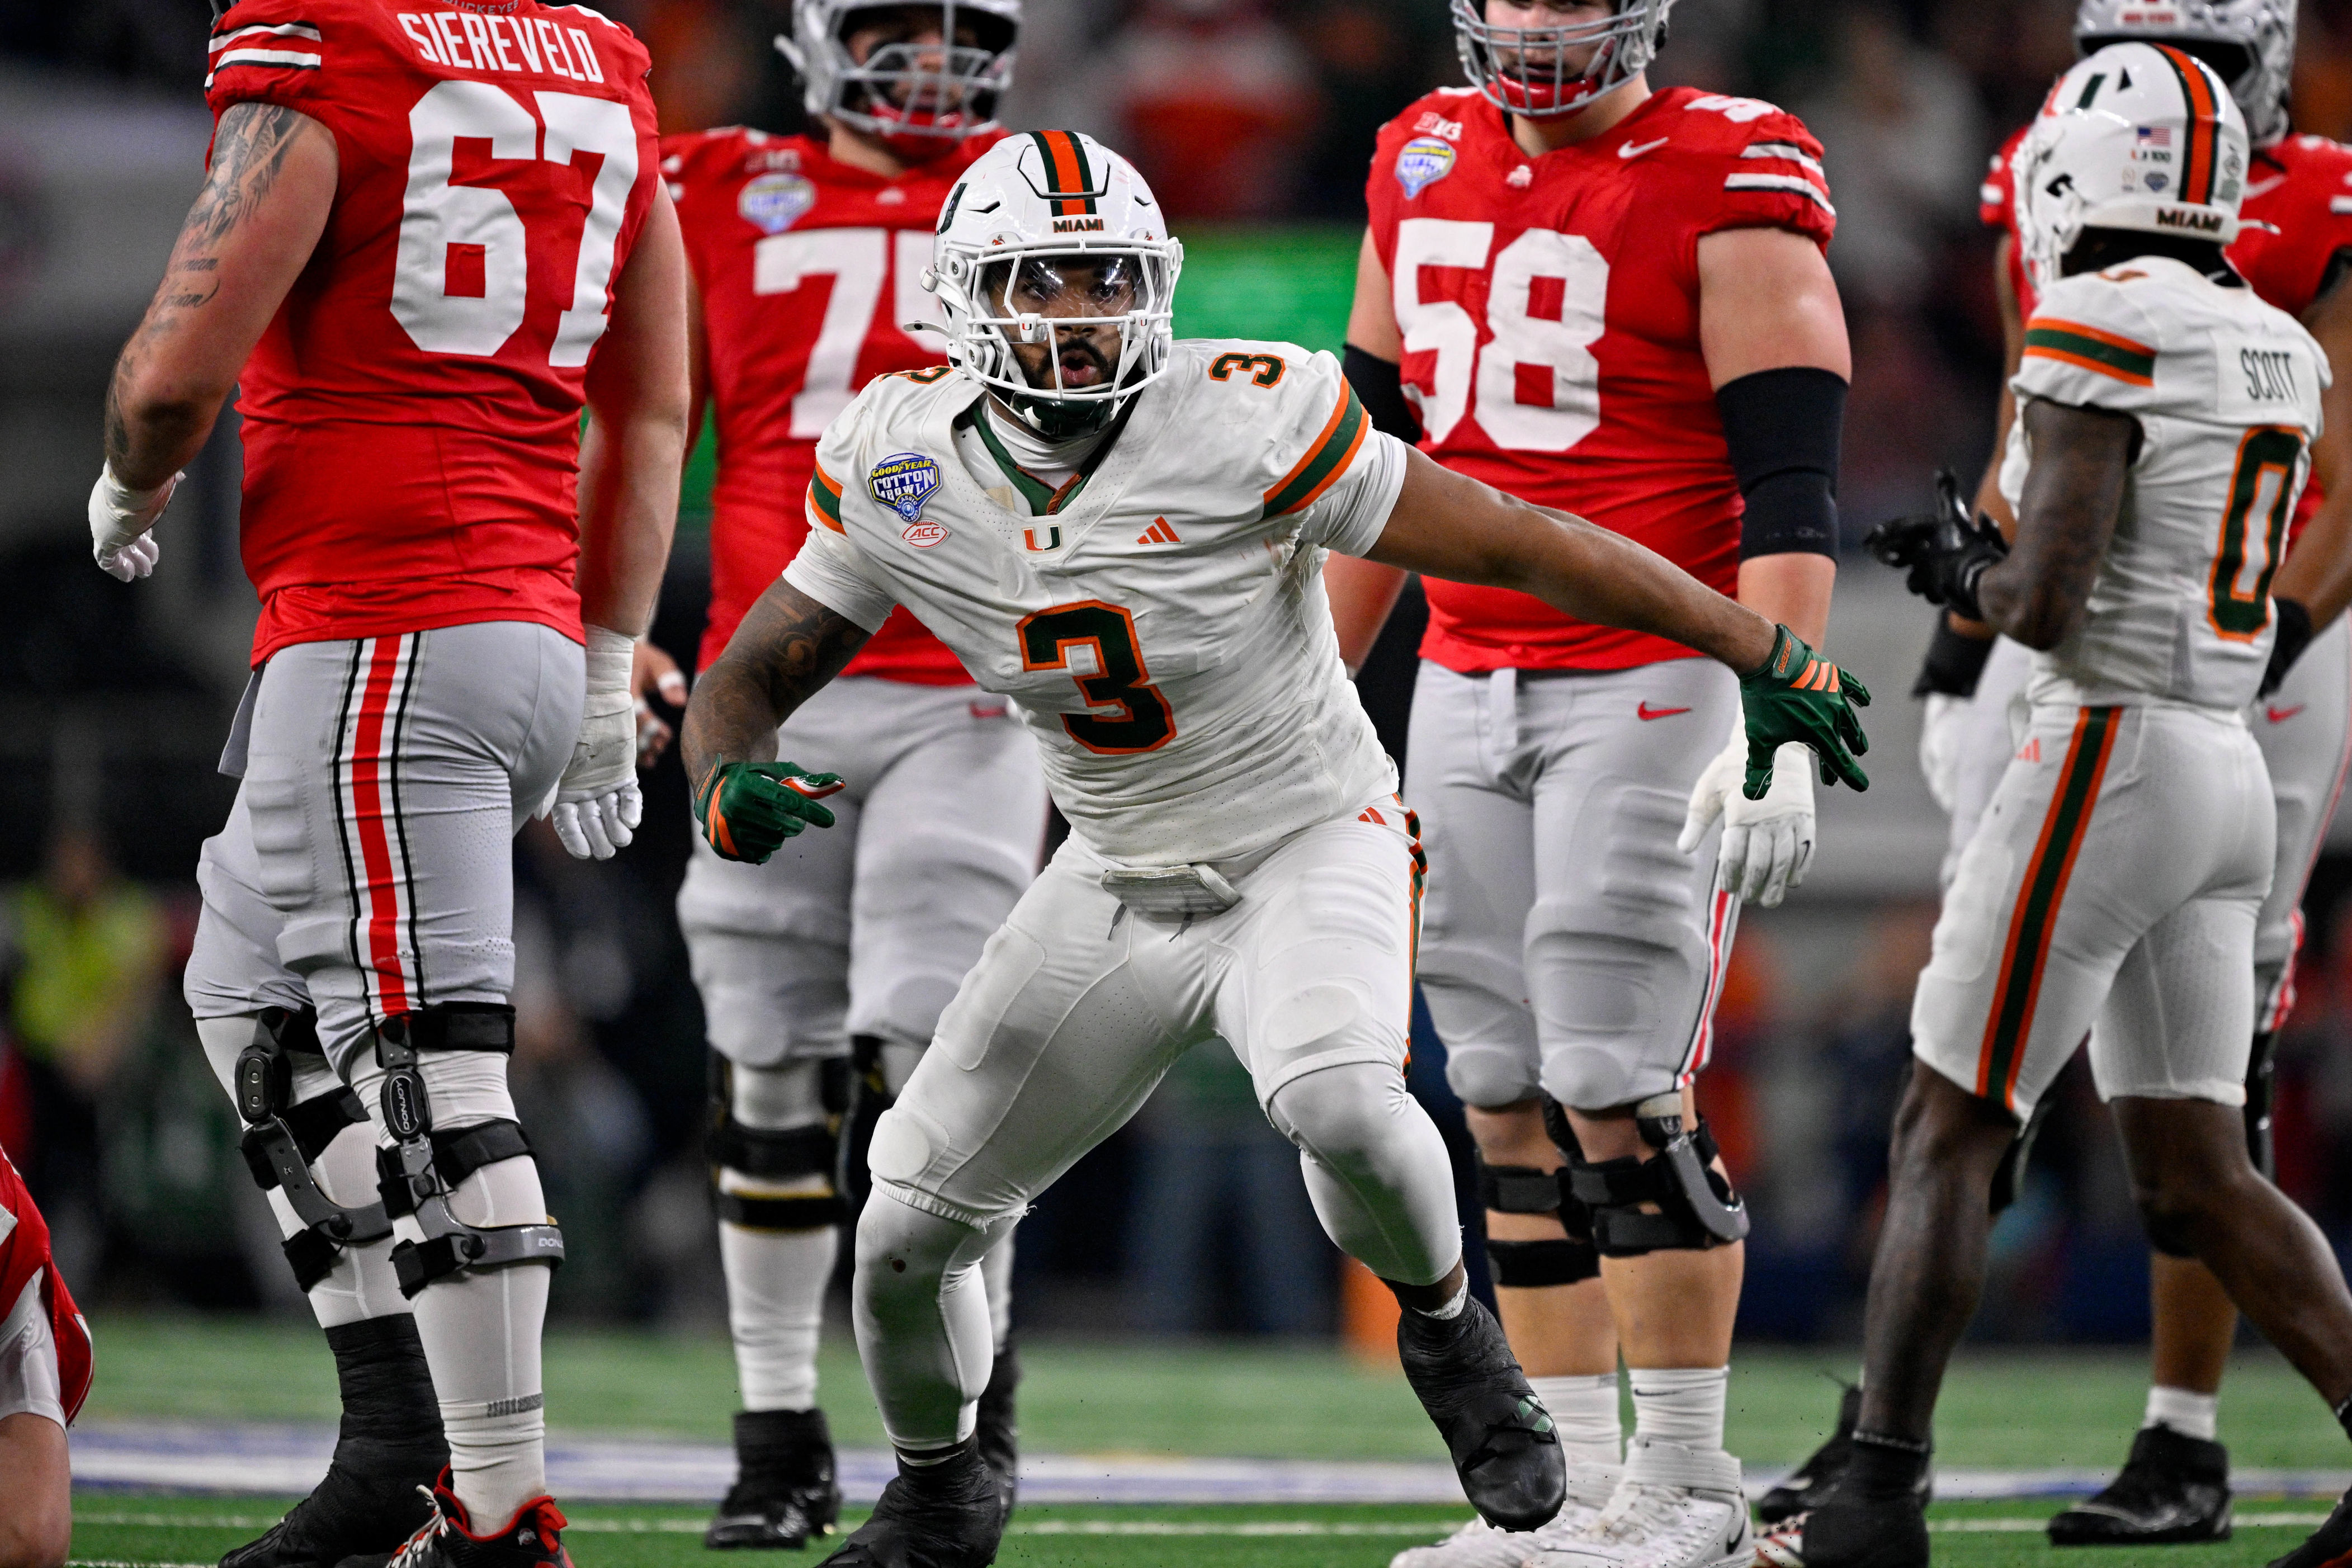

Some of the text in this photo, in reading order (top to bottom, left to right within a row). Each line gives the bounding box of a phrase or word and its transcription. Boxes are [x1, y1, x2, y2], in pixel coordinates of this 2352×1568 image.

[398, 12, 604, 83] SIEREVELD
[390, 80, 639, 367] 67
[1052, 218, 1104, 233] MIAMI
[1022, 322, 1032, 331] U
[1392, 218, 1610, 452] 58
[1208, 352, 1286, 390] 3
[2240, 347, 2301, 403] SCOTT
[873, 469, 937, 498] COTTON
[886, 483, 924, 501] BOWL
[897, 495, 918, 508] CLASSIC
[909, 527, 940, 539] ACC
[1022, 525, 1062, 553] U
[2208, 424, 2306, 643] 0
[1015, 599, 1177, 755] 3
[395, 1079, 410, 1130] DONJOY
